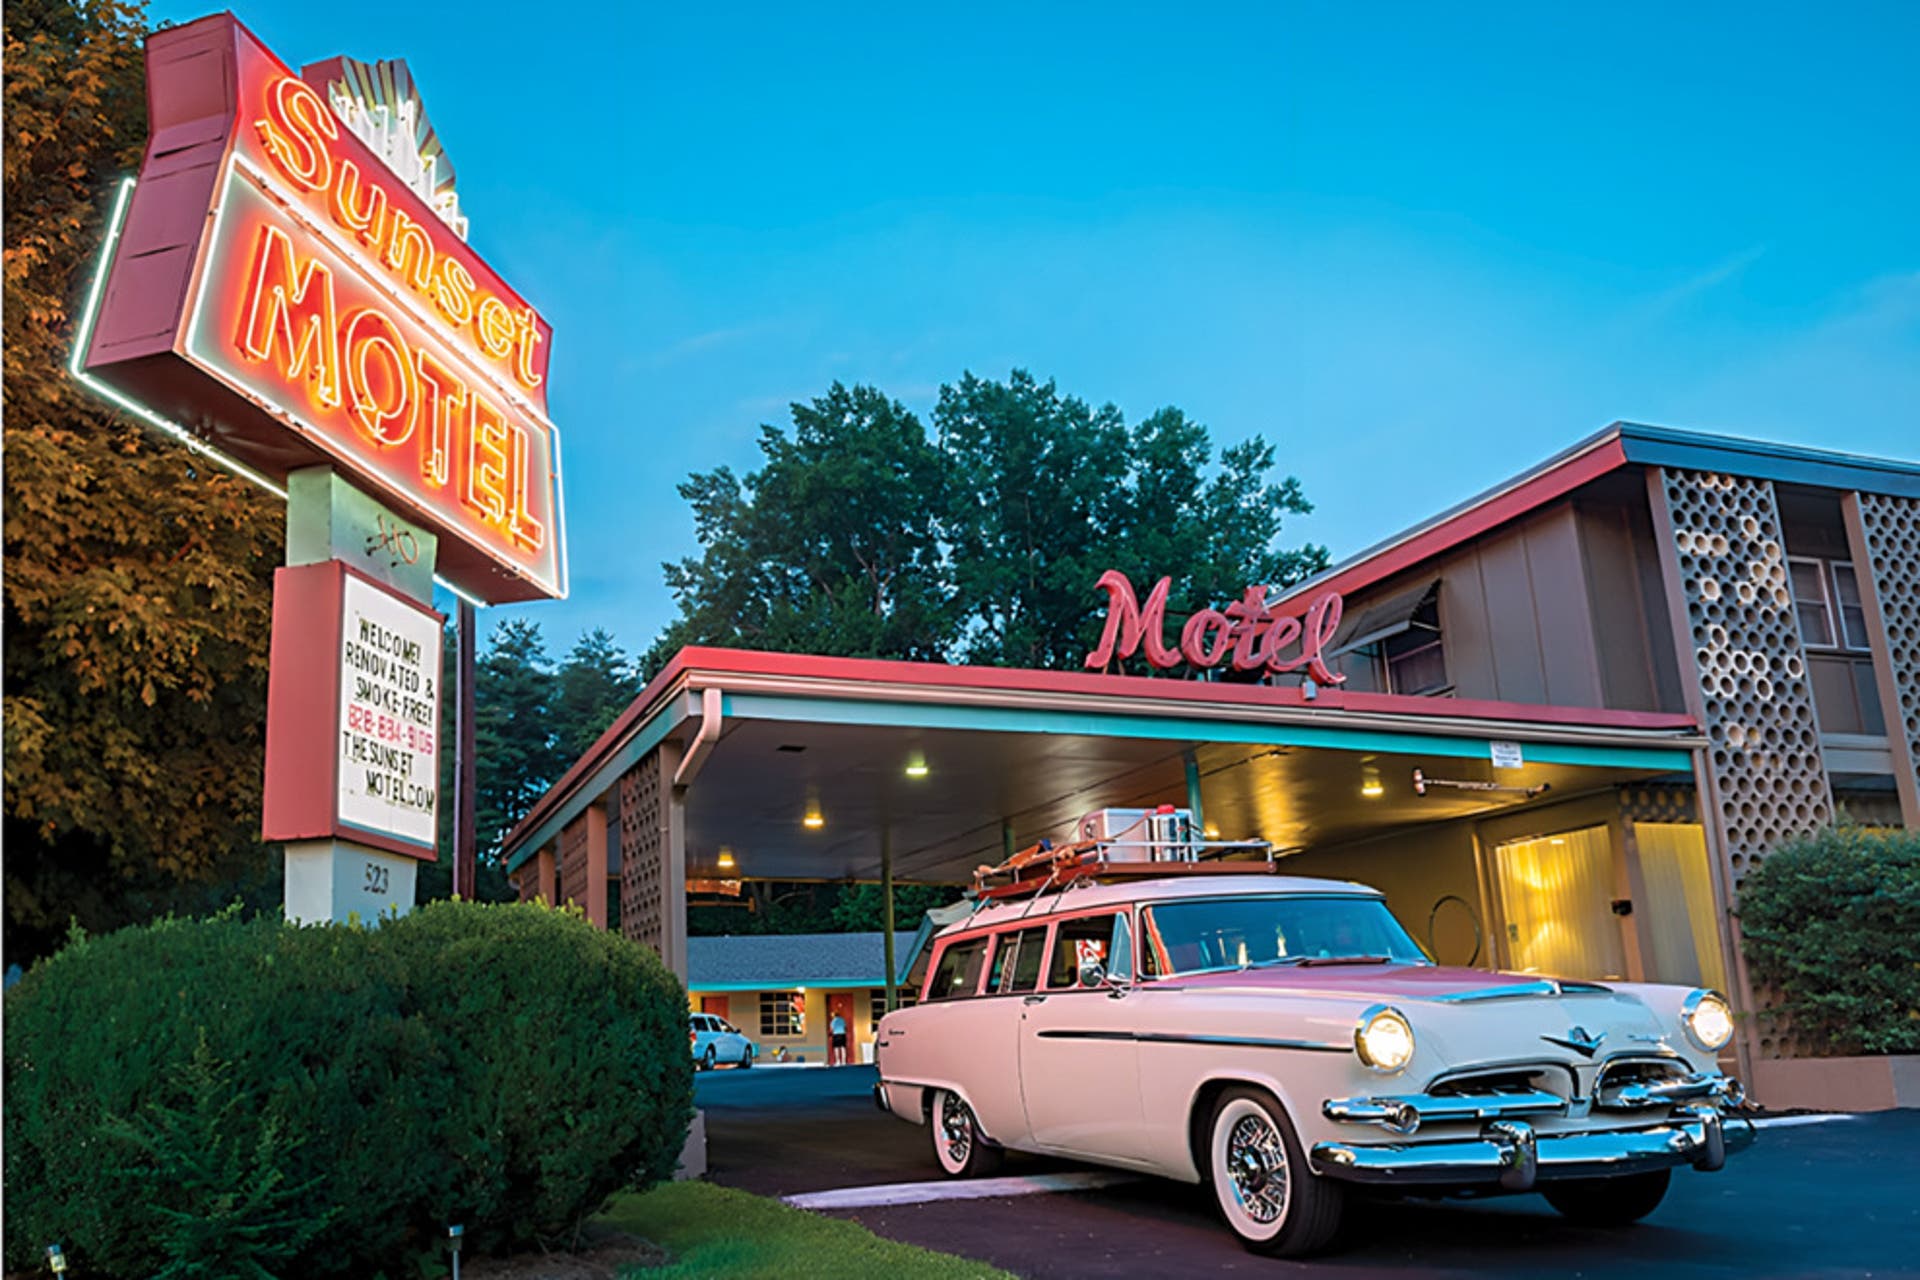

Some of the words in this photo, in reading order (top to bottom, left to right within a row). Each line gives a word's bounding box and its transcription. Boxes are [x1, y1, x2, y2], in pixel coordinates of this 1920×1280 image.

[254, 76, 543, 388] Sunset
[234, 224, 545, 553] MOTEL
[345, 641, 420, 693] RENOVATED
[425, 677, 435, 700] &
[359, 618, 421, 667] WELCOME!
[1084, 569, 1347, 686] Motel
[363, 863, 389, 894] 523
